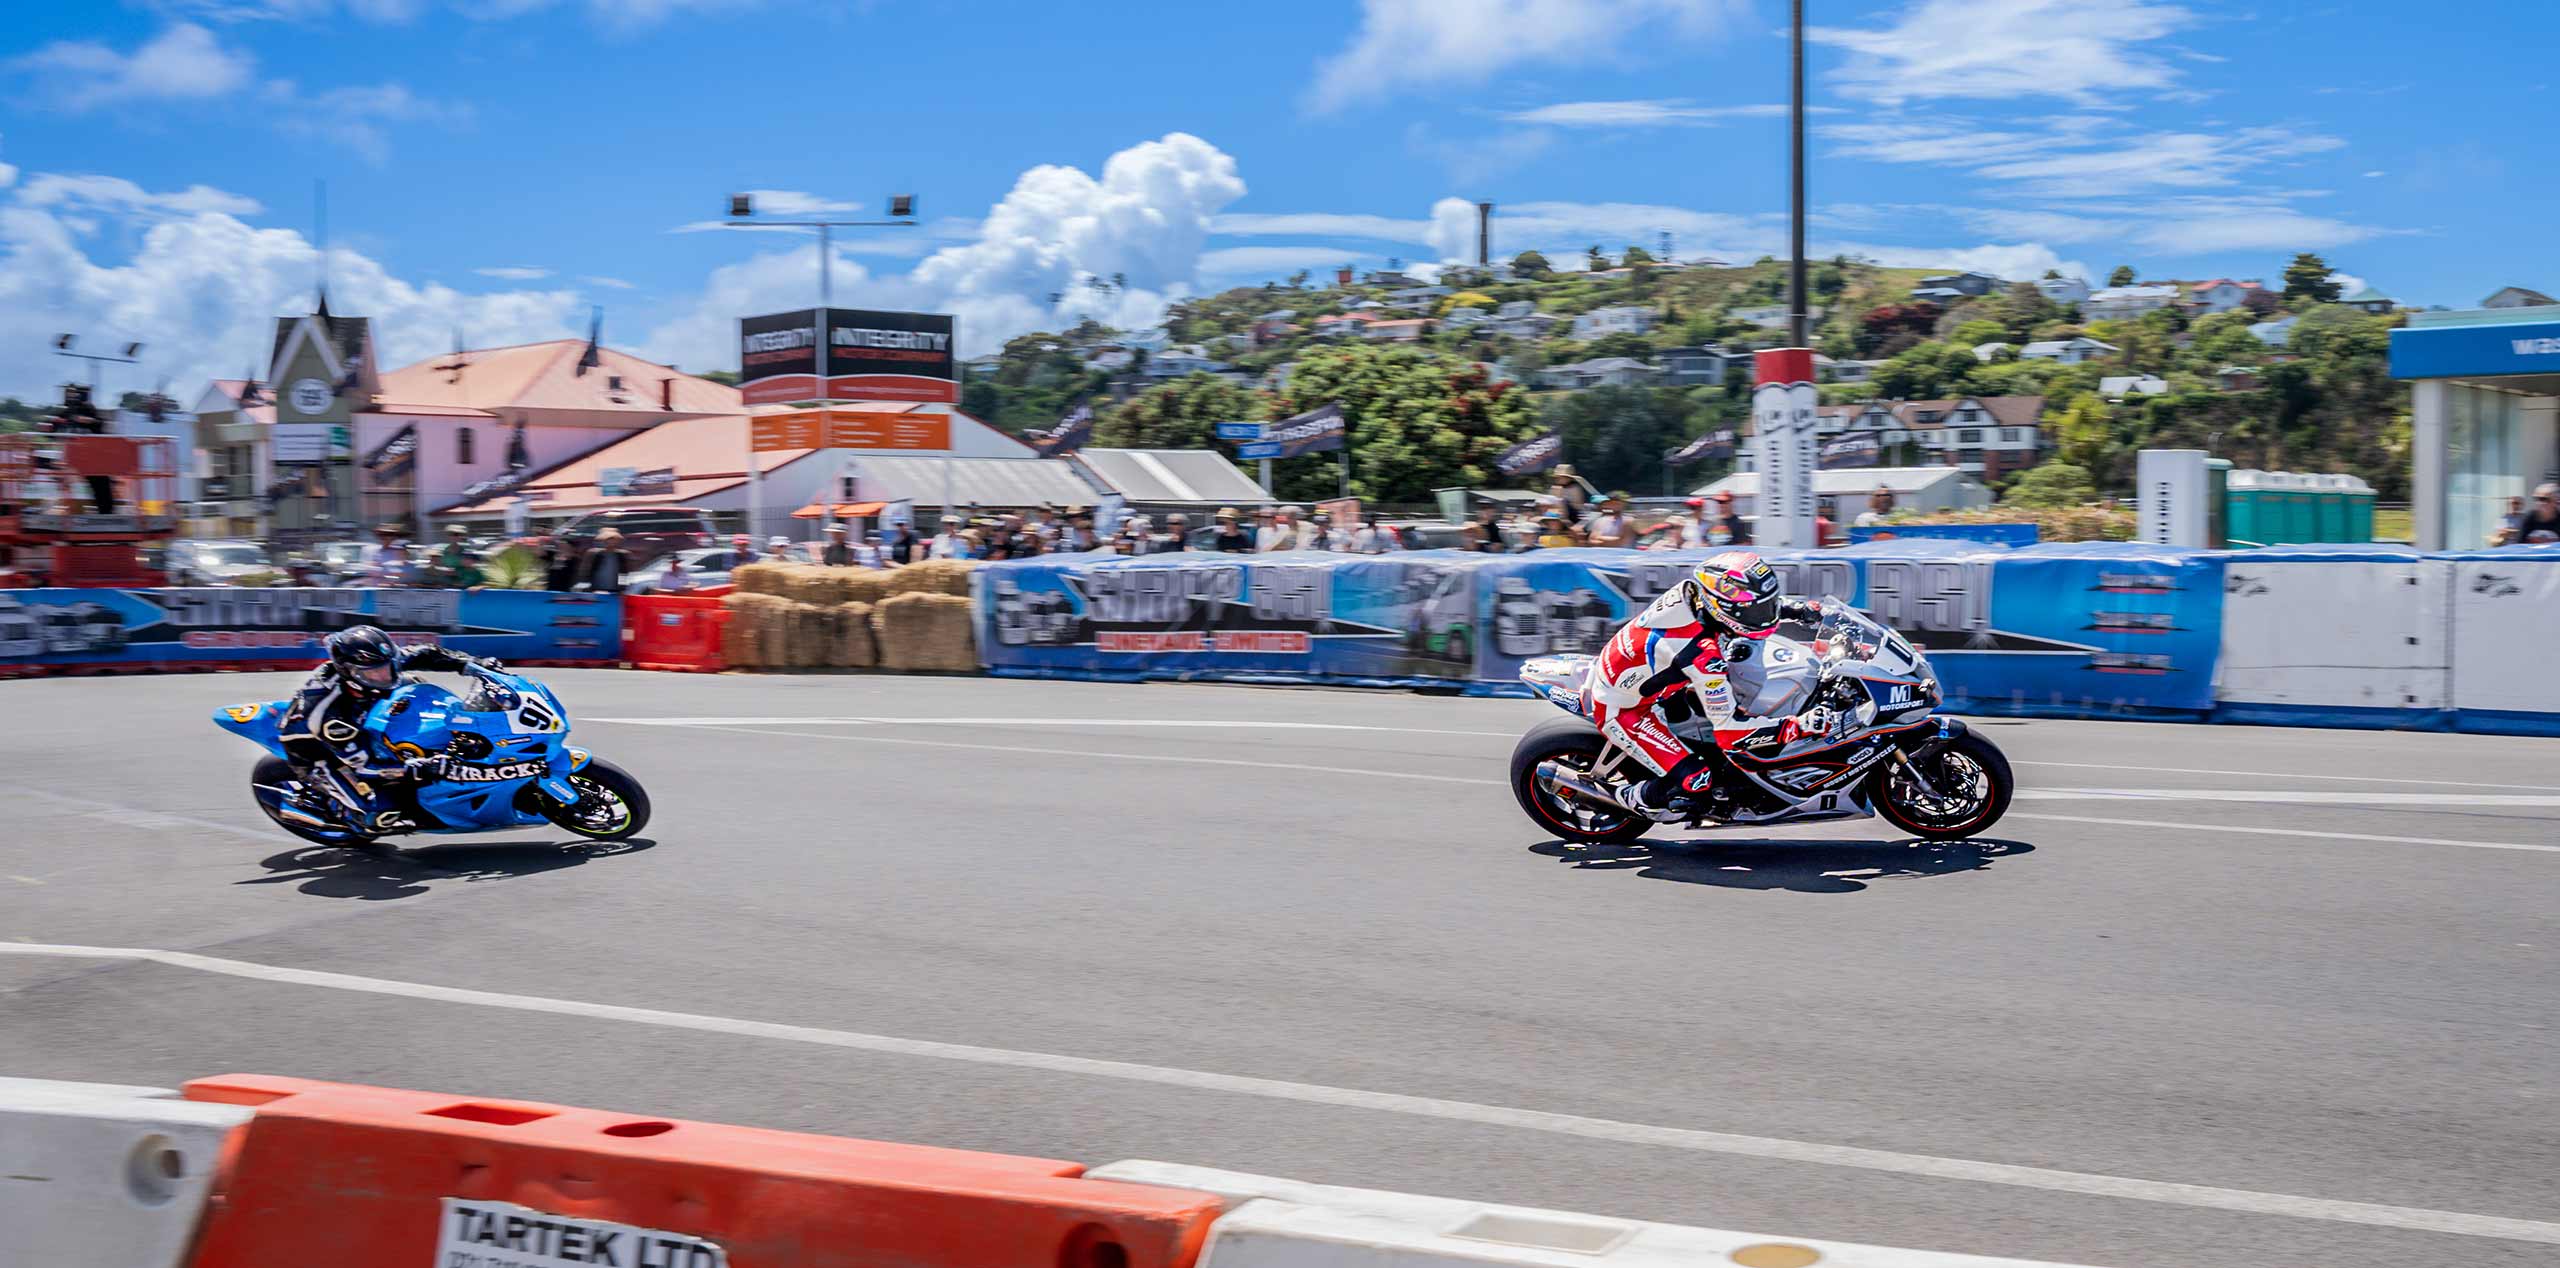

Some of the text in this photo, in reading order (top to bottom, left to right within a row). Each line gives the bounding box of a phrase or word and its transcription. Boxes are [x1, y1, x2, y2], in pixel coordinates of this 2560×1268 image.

[831, 327, 951, 350] INTEGRITY
[519, 697, 554, 731] 91
[1880, 700, 1924, 711] MOTORSPORT
[1632, 717, 1681, 752] Milwaukee
[1848, 743, 1896, 776] MOTORCYCLES
[455, 1206, 716, 1268] TARTEK LTD
